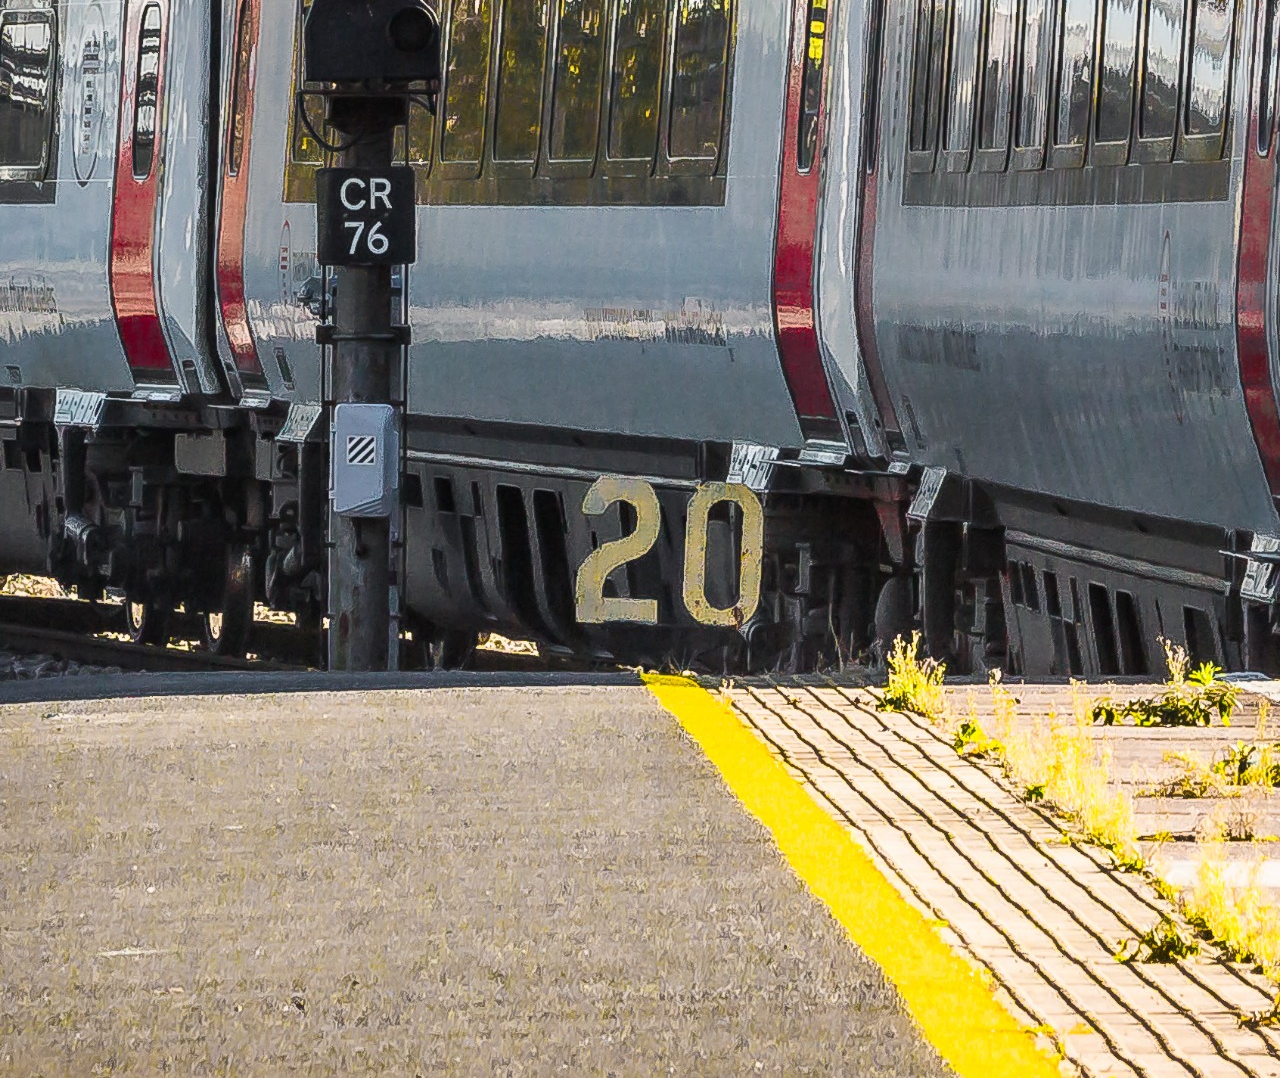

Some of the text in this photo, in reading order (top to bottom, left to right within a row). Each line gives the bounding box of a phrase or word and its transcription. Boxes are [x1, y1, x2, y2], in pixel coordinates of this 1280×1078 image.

[340, 177, 392, 211] CR
[344, 221, 389, 255] 76
[575, 475, 764, 627] 20
